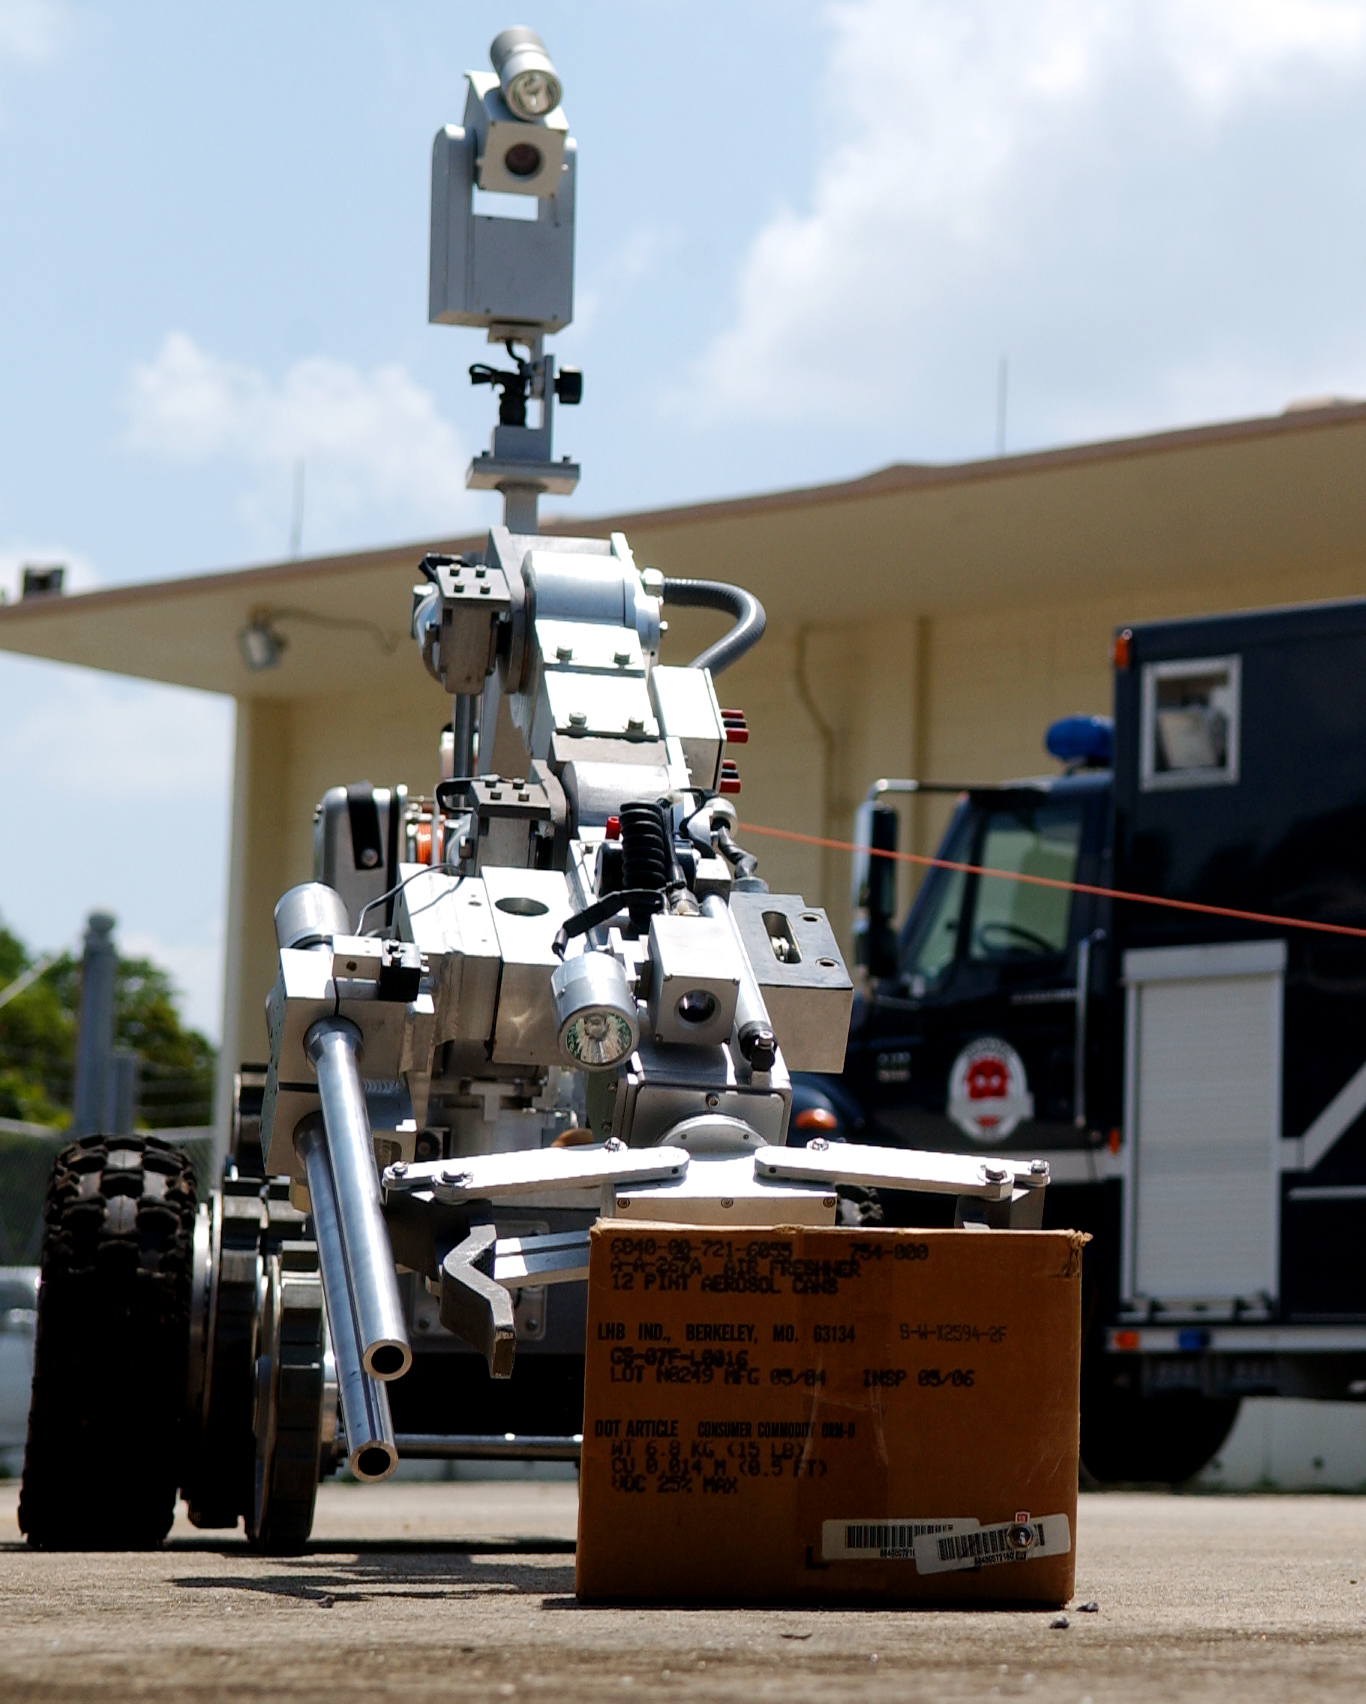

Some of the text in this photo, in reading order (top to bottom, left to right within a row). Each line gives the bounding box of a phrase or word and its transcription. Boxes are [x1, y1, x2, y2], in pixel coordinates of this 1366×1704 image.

[724, 1257, 758, 1278] AIR
[612, 1273, 839, 1294] 12 PINT AEROSOL CANS
[597, 1323, 625, 1341] LHB
[638, 1323, 671, 1343] IND.,
[685, 1324, 758, 1345] BERKELEY,
[773, 1325, 799, 1342] MO.
[813, 1325, 855, 1343] 63134
[610, 1365, 645, 1383] LOT
[724, 1367, 759, 1385] MFG
[863, 1368, 907, 1387] INSP
[595, 1419, 621, 1437] DOT
[625, 1419, 678, 1438] ARTICLE
[697, 1421, 752, 1438] CONSUMER
[821, 1421, 856, 1439] ORM-D
[611, 1439, 805, 1460] WT 6.8 KG (15 LB)
[611, 1456, 635, 1474] CU
[646, 1457, 702, 1476] 0.014
[739, 1459, 783, 1478] (0.5
[793, 1459, 828, 1478] FT)
[702, 1476, 738, 1496] MAX
